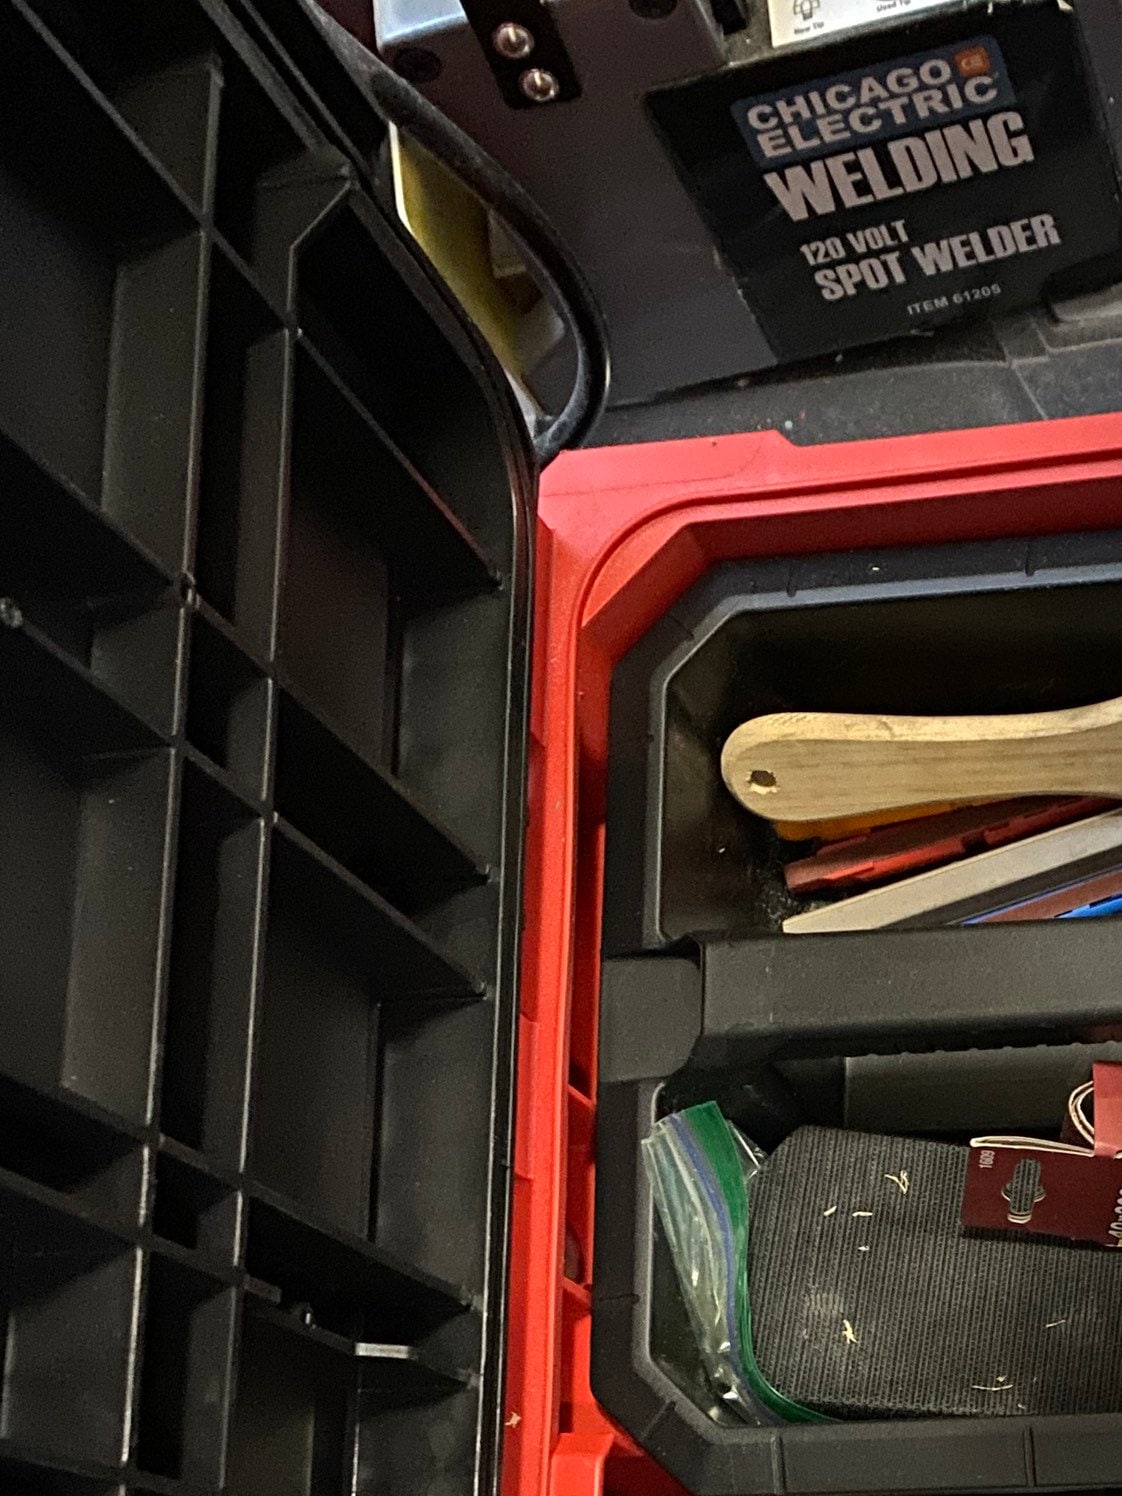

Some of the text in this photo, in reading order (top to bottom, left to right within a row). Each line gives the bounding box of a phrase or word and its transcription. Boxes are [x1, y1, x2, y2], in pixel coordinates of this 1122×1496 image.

[746, 57, 952, 132] CHICAGO
[756, 75, 1000, 159] ELECTRIC
[763, 110, 1036, 223] WELDING
[800, 219, 910, 267] 120 VOLT
[813, 213, 1063, 302] SPOT WELDER
[906, 296, 950, 316] ITEM
